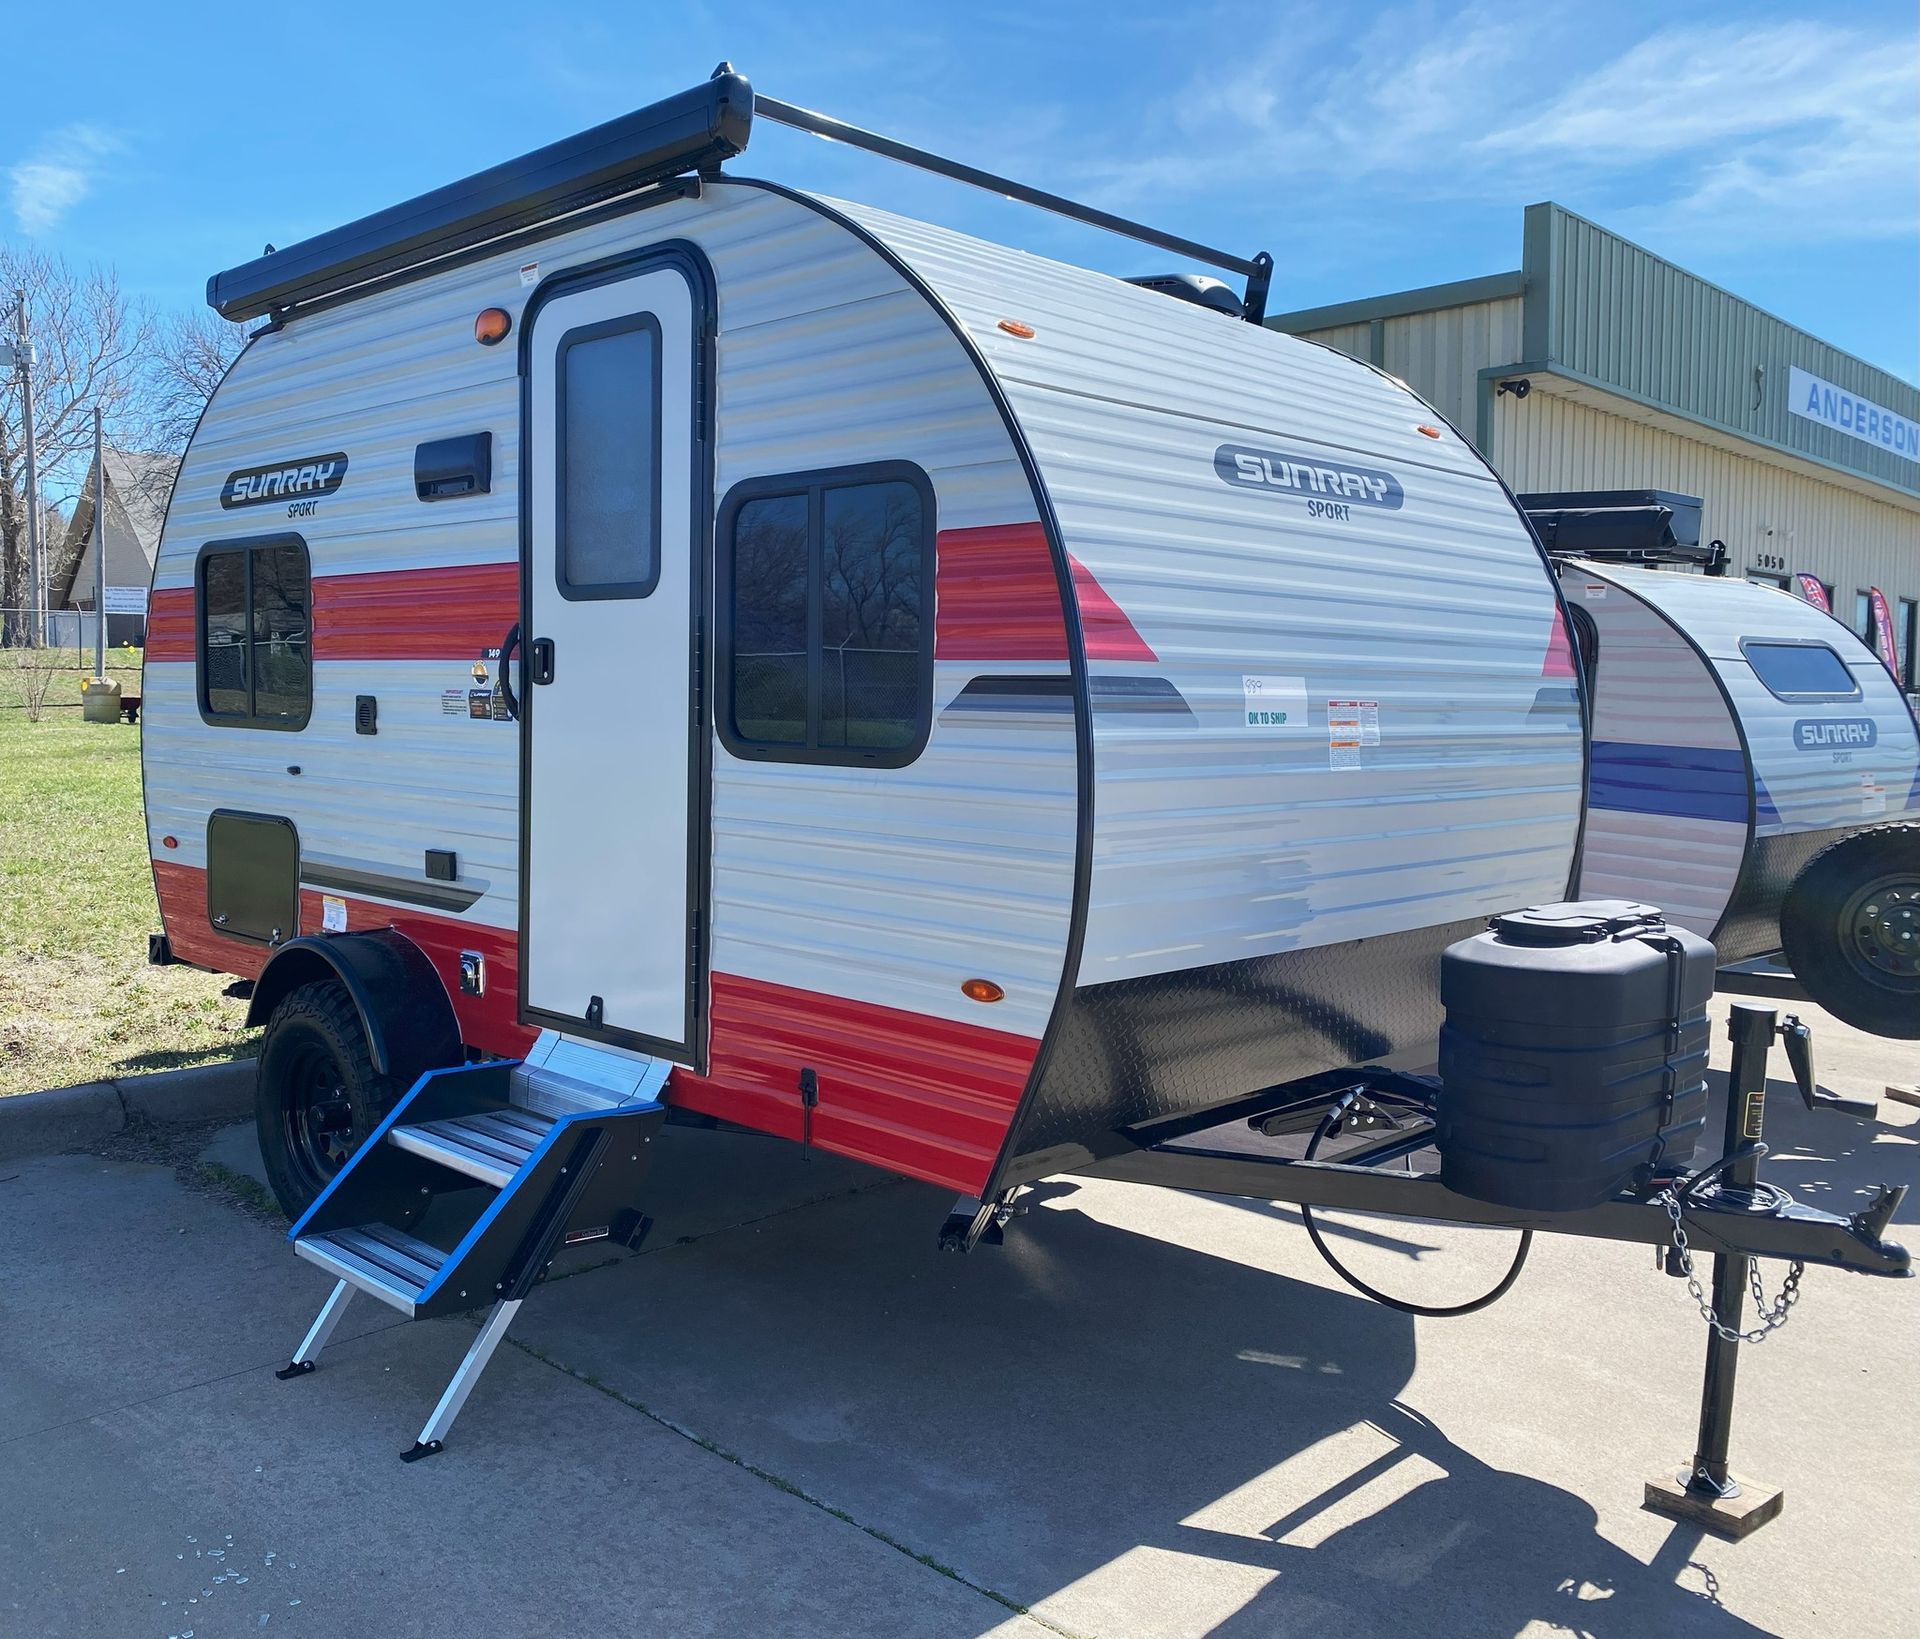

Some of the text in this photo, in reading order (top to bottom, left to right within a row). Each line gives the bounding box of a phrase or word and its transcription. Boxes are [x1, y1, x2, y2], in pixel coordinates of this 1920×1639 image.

[1807, 383, 1920, 456] ANDERSON
[231, 462, 335, 502] SUNRAY
[1235, 454, 1388, 501] SUNRAY
[288, 501, 318, 518] SPORT
[1308, 500, 1350, 522] SPORT
[1757, 554, 1785, 570] 5050
[1248, 711, 1287, 725] OK TO SHIP
[1801, 724, 1871, 745] SUNRAY
[1832, 752, 1852, 764] SPORT
